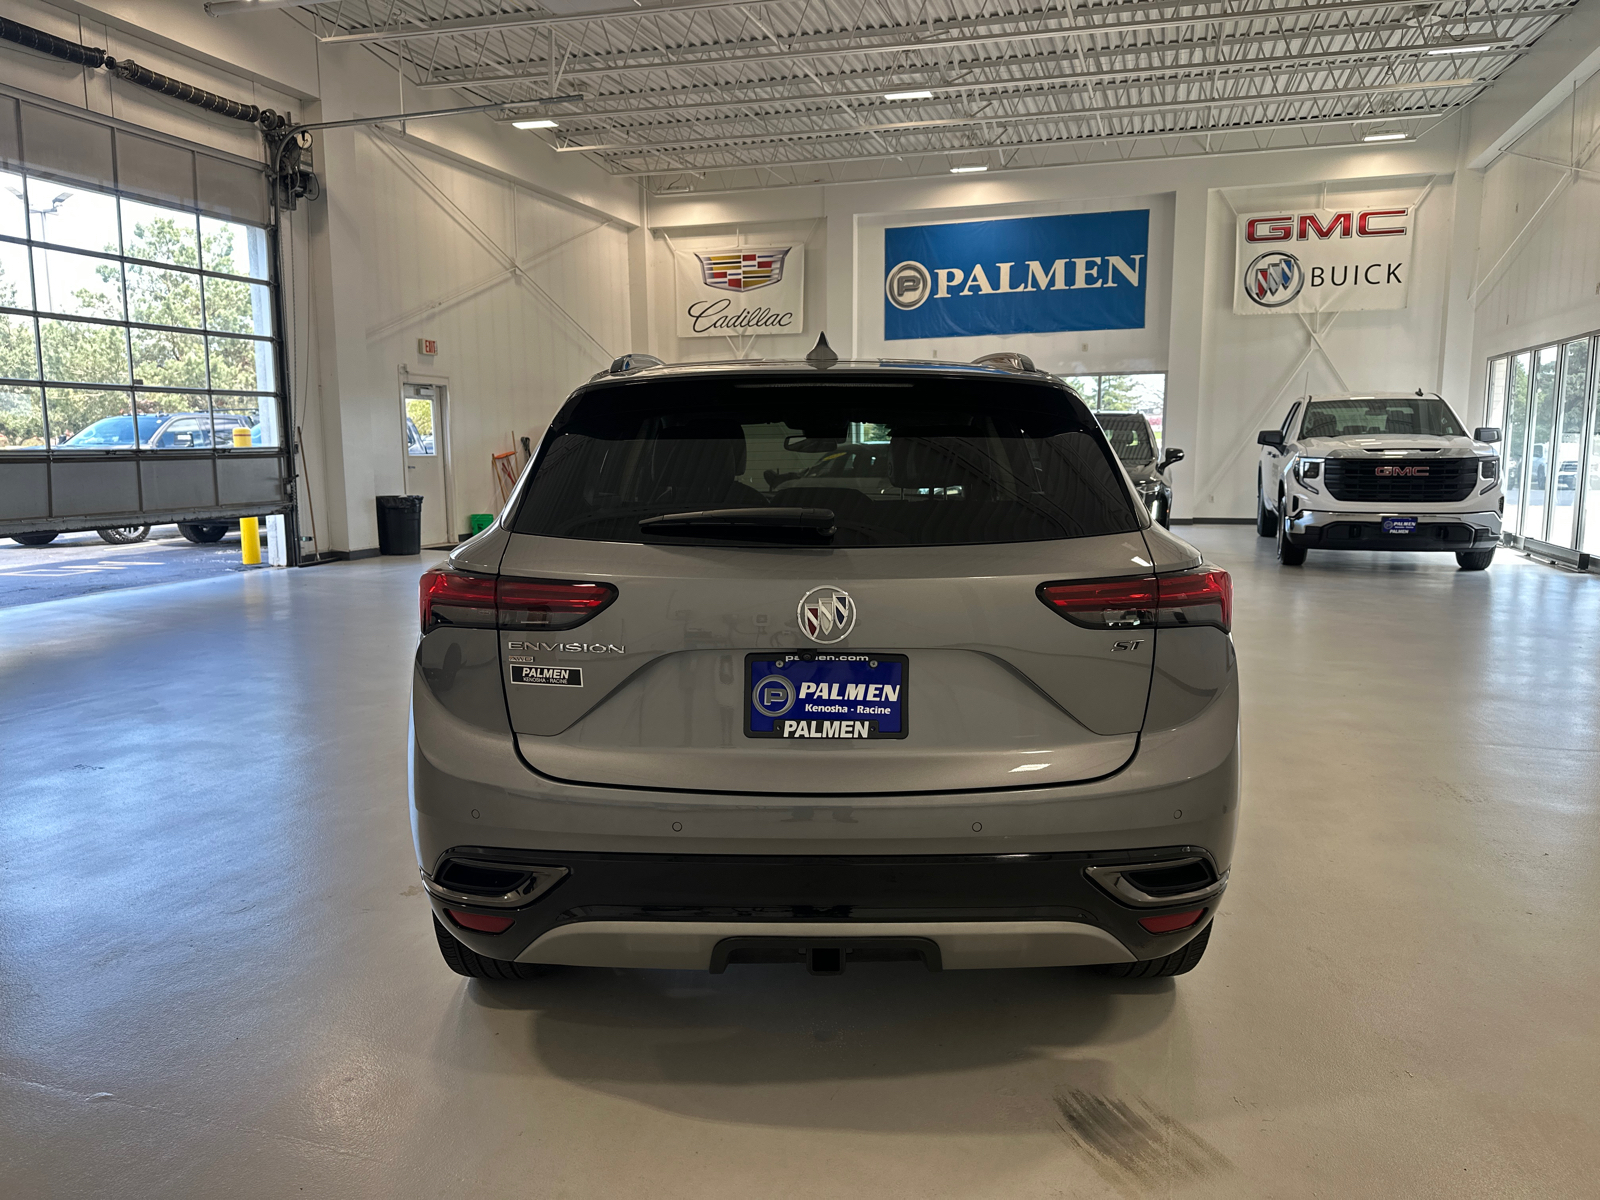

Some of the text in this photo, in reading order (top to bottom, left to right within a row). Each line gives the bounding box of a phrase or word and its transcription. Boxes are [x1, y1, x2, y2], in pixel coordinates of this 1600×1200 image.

[1245, 208, 1408, 244] GMC
[933, 254, 1145, 299] PALMEN
[1311, 263, 1403, 287] BUICK
[688, 298, 793, 333] Cadillac
[425, 340, 436, 354] EXIT
[1375, 466, 1430, 476] GMC
[508, 641, 625, 654] ENVISION
[1110, 639, 1145, 652] ST
[522, 668, 569, 679] PALMEN
[799, 681, 901, 702] PALMEN
[804, 703, 848, 713] Kenosha
[856, 705, 891, 715] Racine
[783, 720, 869, 738] PALMEN
